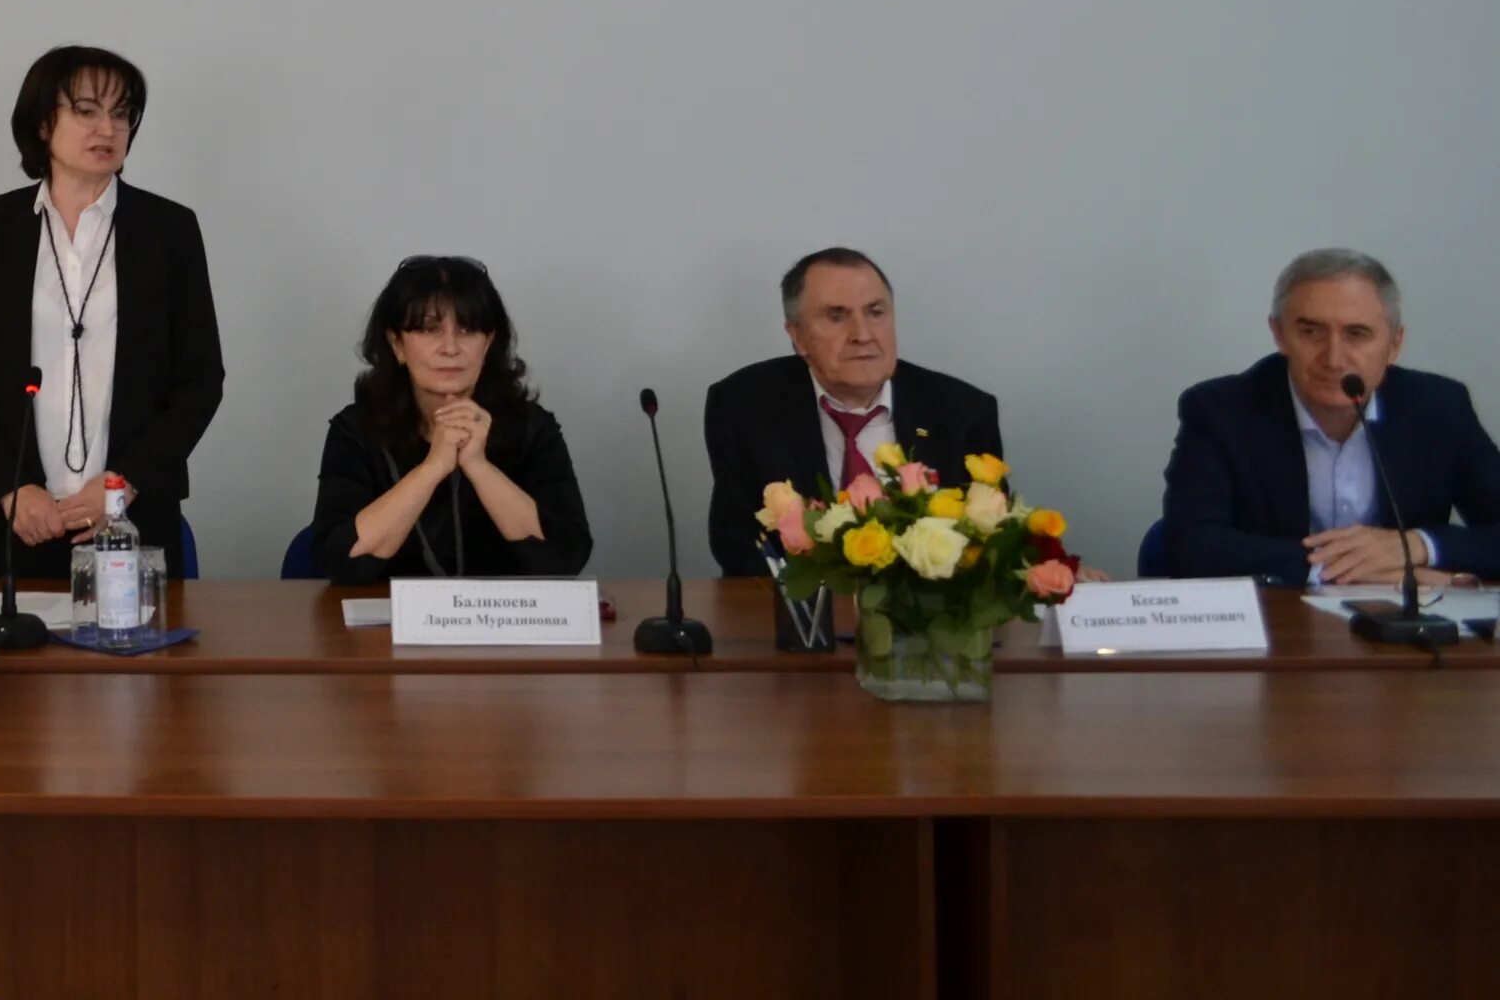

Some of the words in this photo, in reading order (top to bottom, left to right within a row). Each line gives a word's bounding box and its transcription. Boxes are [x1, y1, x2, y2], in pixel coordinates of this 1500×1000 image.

[452, 594, 538, 609] Баликоева
[1131, 593, 1179, 607] Кесаев
[422, 613, 472, 628] Лариса
[476, 613, 568, 629] Мурадиновна
[1070, 615, 1148, 628] Станислав
[1151, 611, 1246, 626] Магометович
